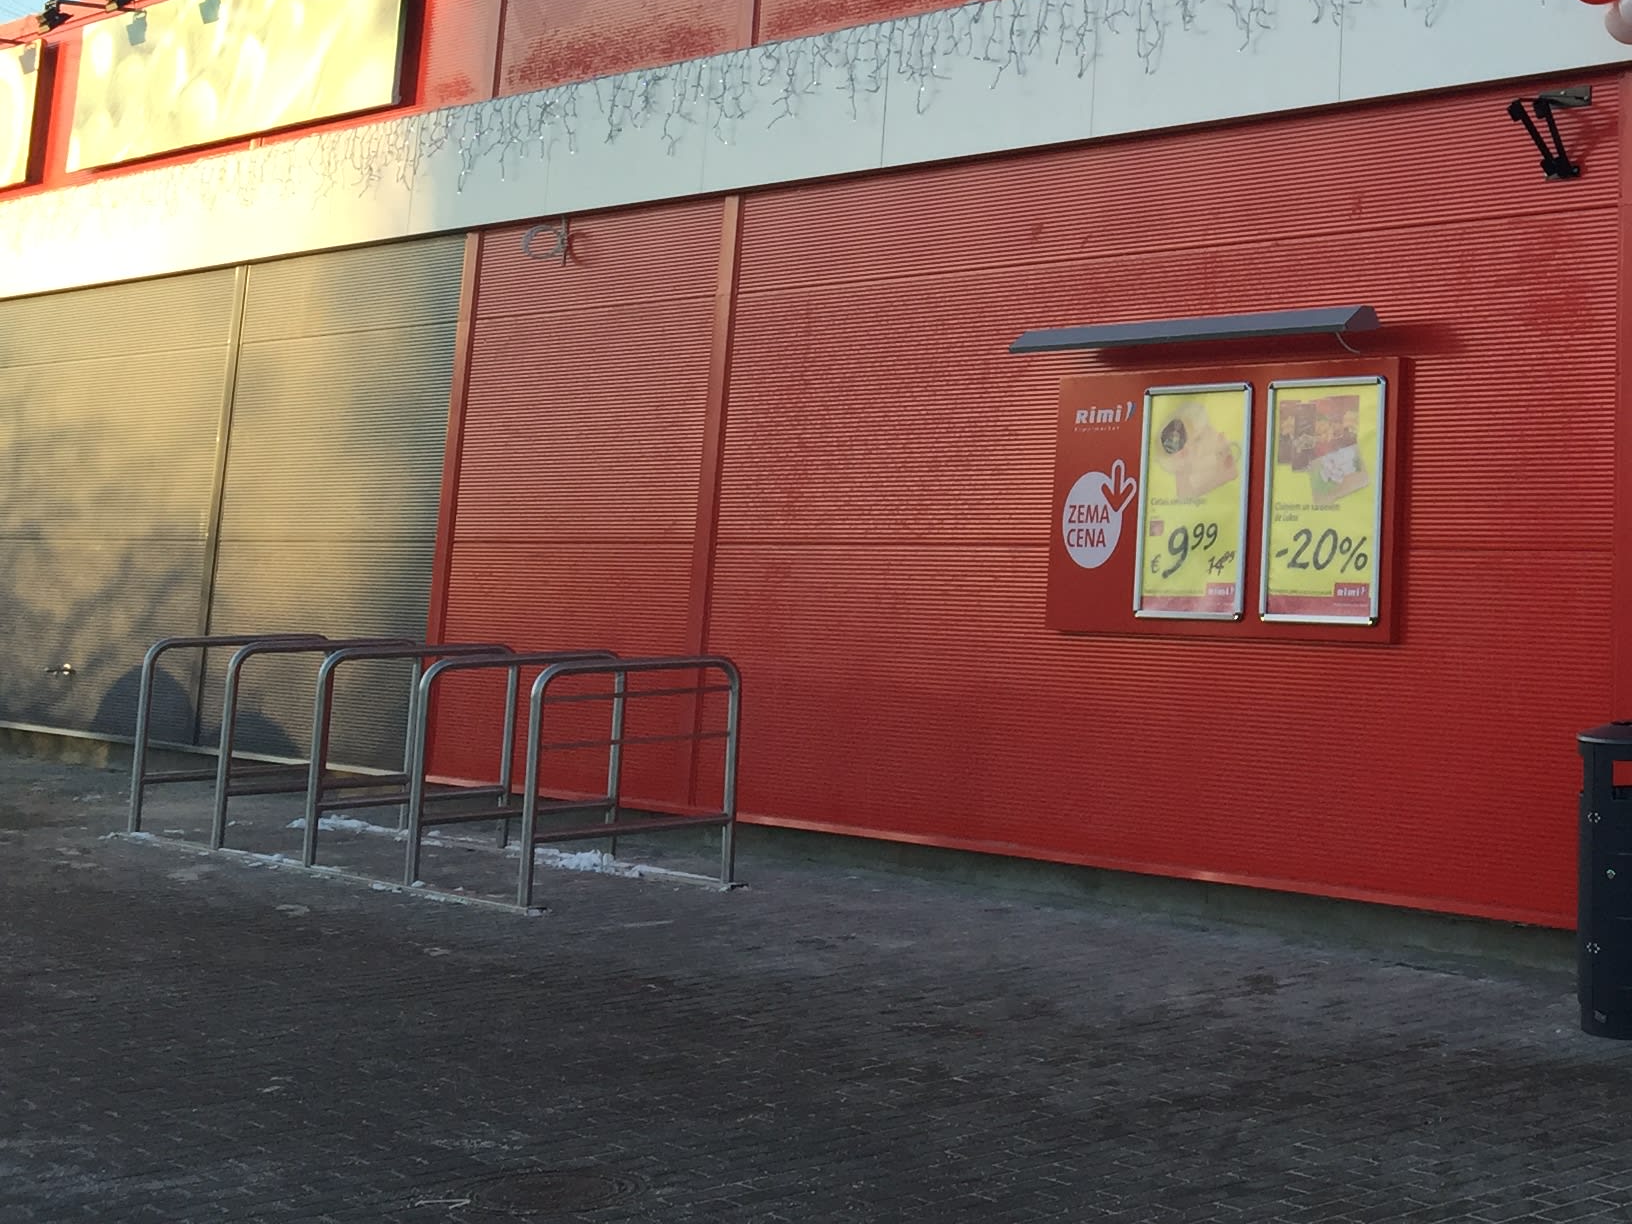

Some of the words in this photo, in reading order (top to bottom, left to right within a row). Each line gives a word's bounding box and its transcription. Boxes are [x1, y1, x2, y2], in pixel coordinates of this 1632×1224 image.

[1075, 404, 1123, 424] Rimi
[1068, 504, 1111, 524] ZEMA
[1066, 528, 1107, 547] CENA
[1275, 527, 1369, 574] -20%
